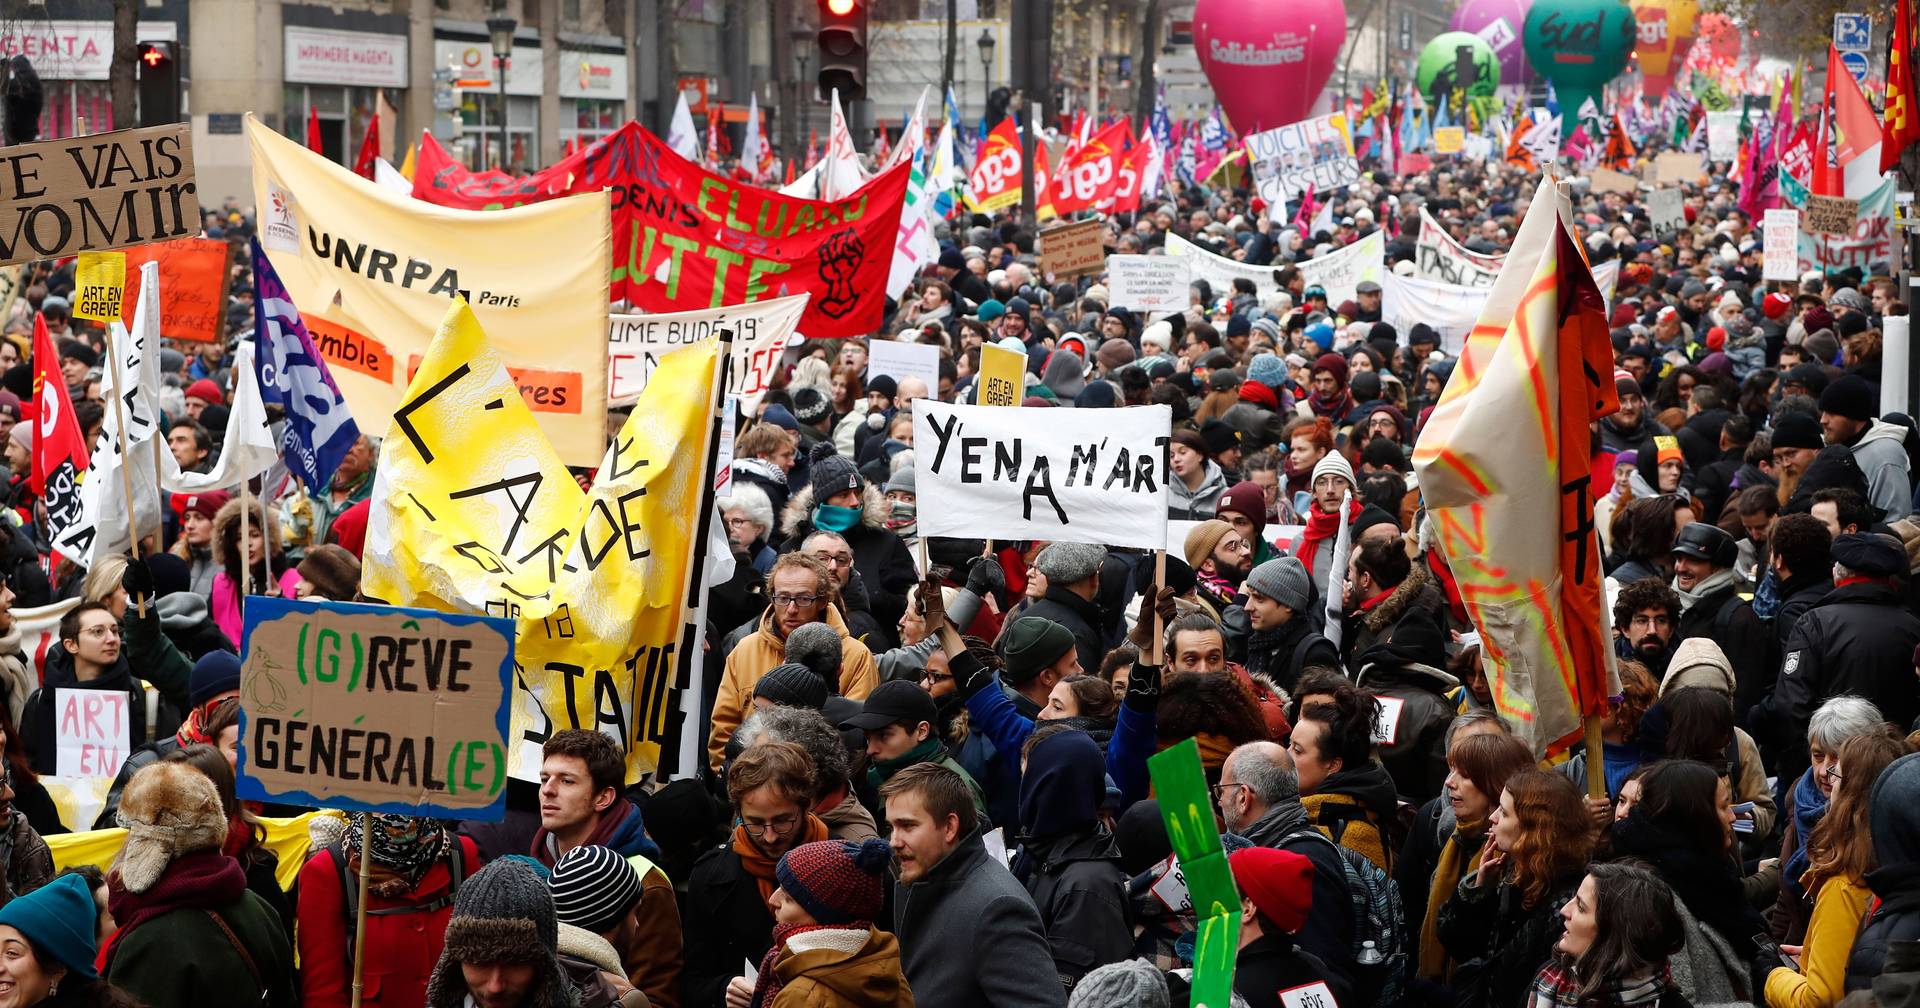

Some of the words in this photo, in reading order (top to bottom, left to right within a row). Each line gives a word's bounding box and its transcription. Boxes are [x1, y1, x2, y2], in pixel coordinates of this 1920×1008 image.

[1210, 38, 1305, 66] Solidaires
[1838, 18, 1857, 42] P
[0, 153, 47, 200] E
[65, 135, 183, 190] VAIS
[308, 225, 459, 299] UNRPA
[478, 291, 521, 308] Paris
[611, 219, 791, 308] UTTE
[108, 287, 122, 301] EN
[988, 377, 1003, 392] ART
[1004, 380, 1014, 396] EN
[925, 413, 1022, 484] Y'EN
[1022, 455, 1070, 525] A
[1064, 436, 1171, 494] M'ART
[61, 693, 124, 740] ART
[80, 743, 119, 778] EN
[254, 708, 505, 796] GÉNÉRAL(E)
